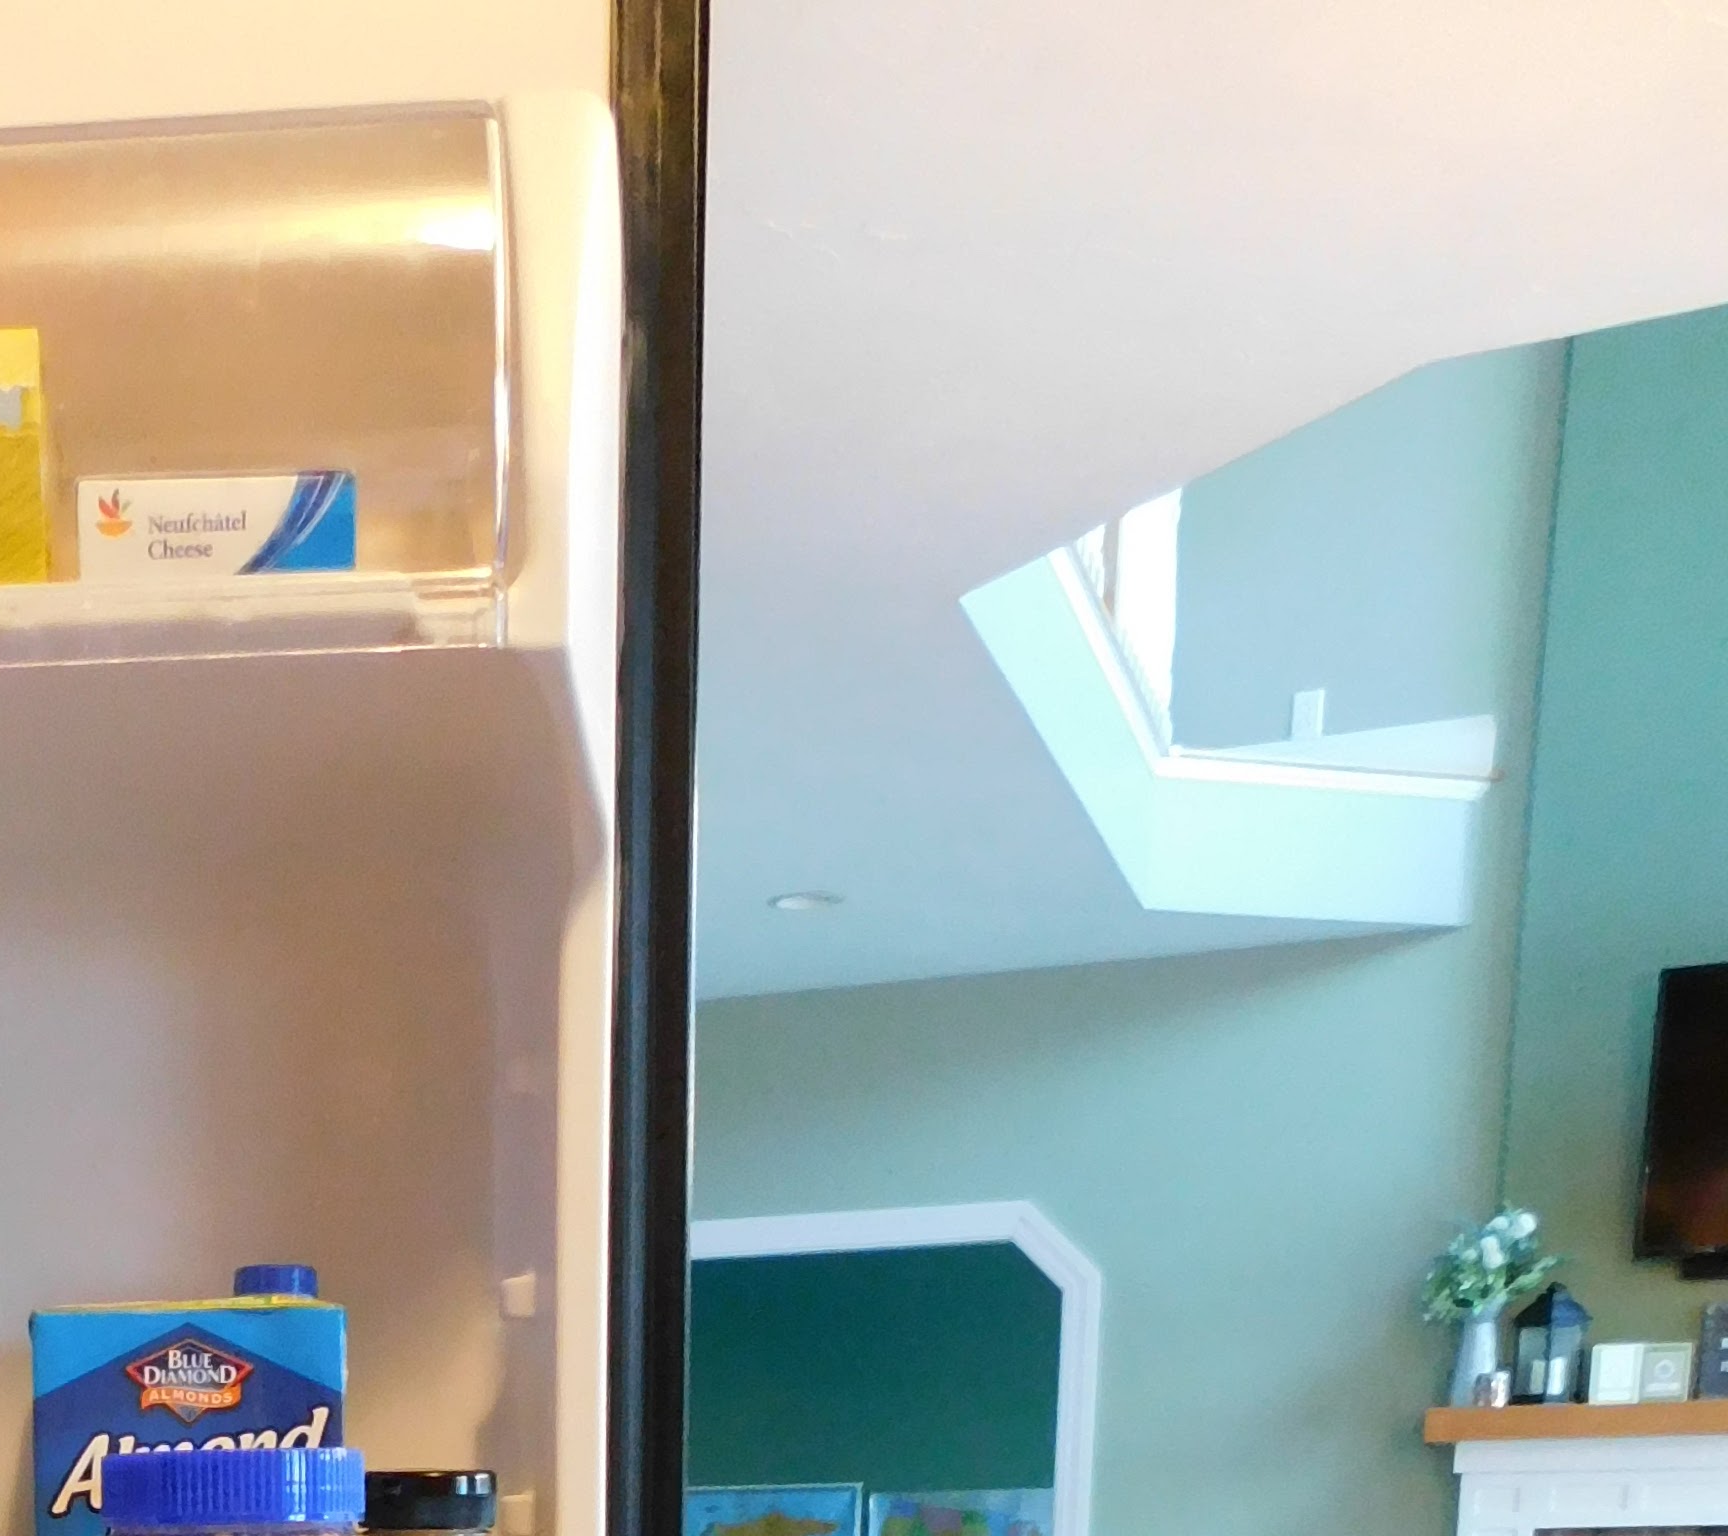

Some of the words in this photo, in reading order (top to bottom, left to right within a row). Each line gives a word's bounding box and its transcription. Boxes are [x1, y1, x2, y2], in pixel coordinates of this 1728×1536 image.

[148, 539, 214, 561] Cheese
[148, 1388, 234, 1405] ALMONDS
[49, 1405, 330, 1517] And
